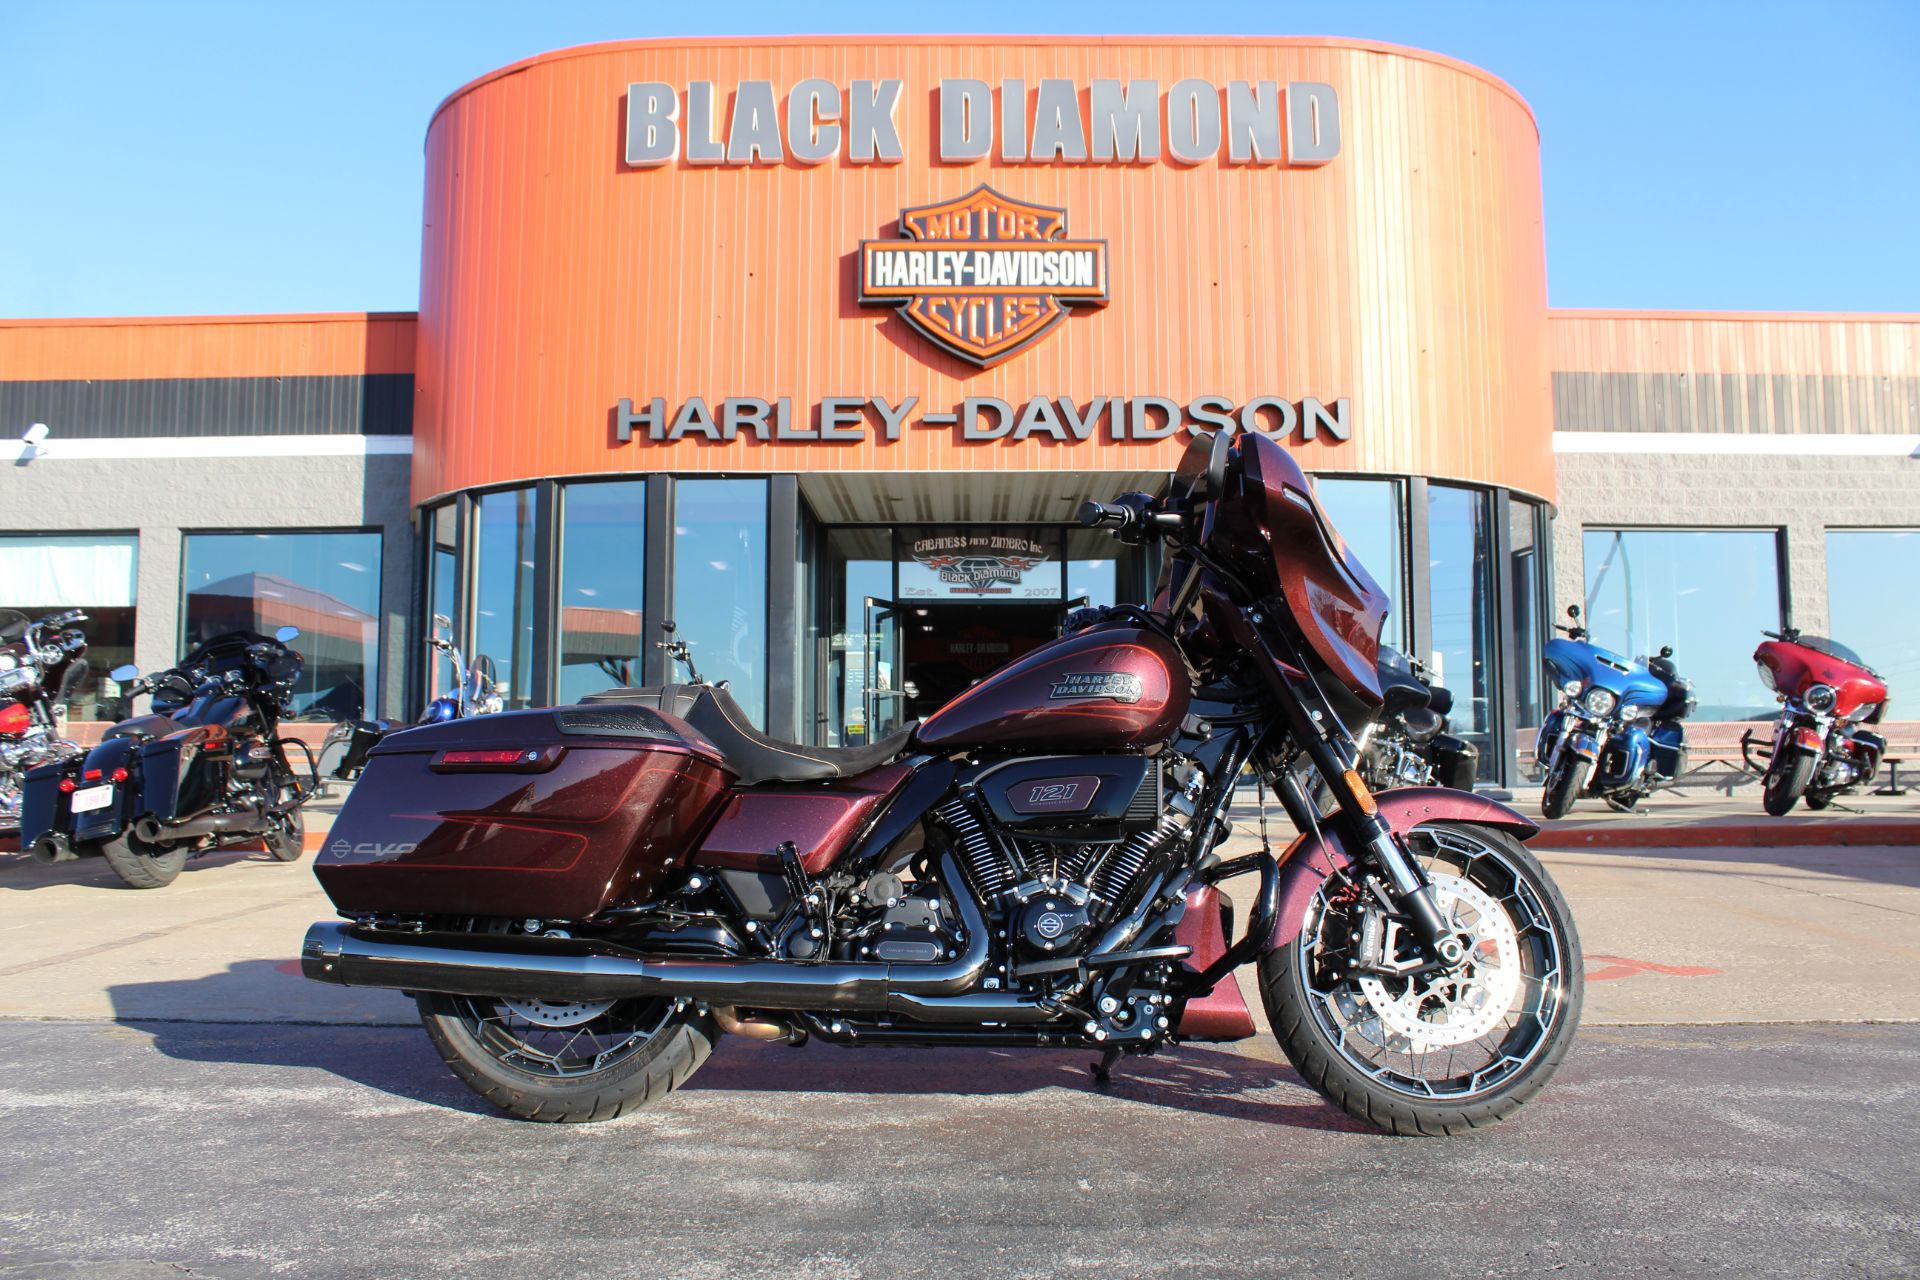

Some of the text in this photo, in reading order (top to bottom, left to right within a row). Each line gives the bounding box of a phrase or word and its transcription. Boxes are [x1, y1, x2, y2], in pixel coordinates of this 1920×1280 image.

[625, 79, 1342, 168] BLACK DIAMOND
[926, 204, 1042, 240] MOTOR
[875, 250, 1093, 287] HARLEY-DAVIDSON
[928, 296, 1041, 346] CYCLES
[616, 395, 1352, 441] HARLEY-DAVIDSON
[990, 536, 1028, 551] ZIMBRO
[904, 587, 937, 596] Est.
[1024, 588, 1057, 597] 2007
[950, 643, 1009, 653] HARLEY-DAV
[1069, 675, 1134, 685] HARLEY
[1056, 684, 1138, 695] DAVIDSON
[1029, 783, 1079, 803] 121
[353, 842, 418, 857] CVO
[1363, 919, 1376, 957] brembo
